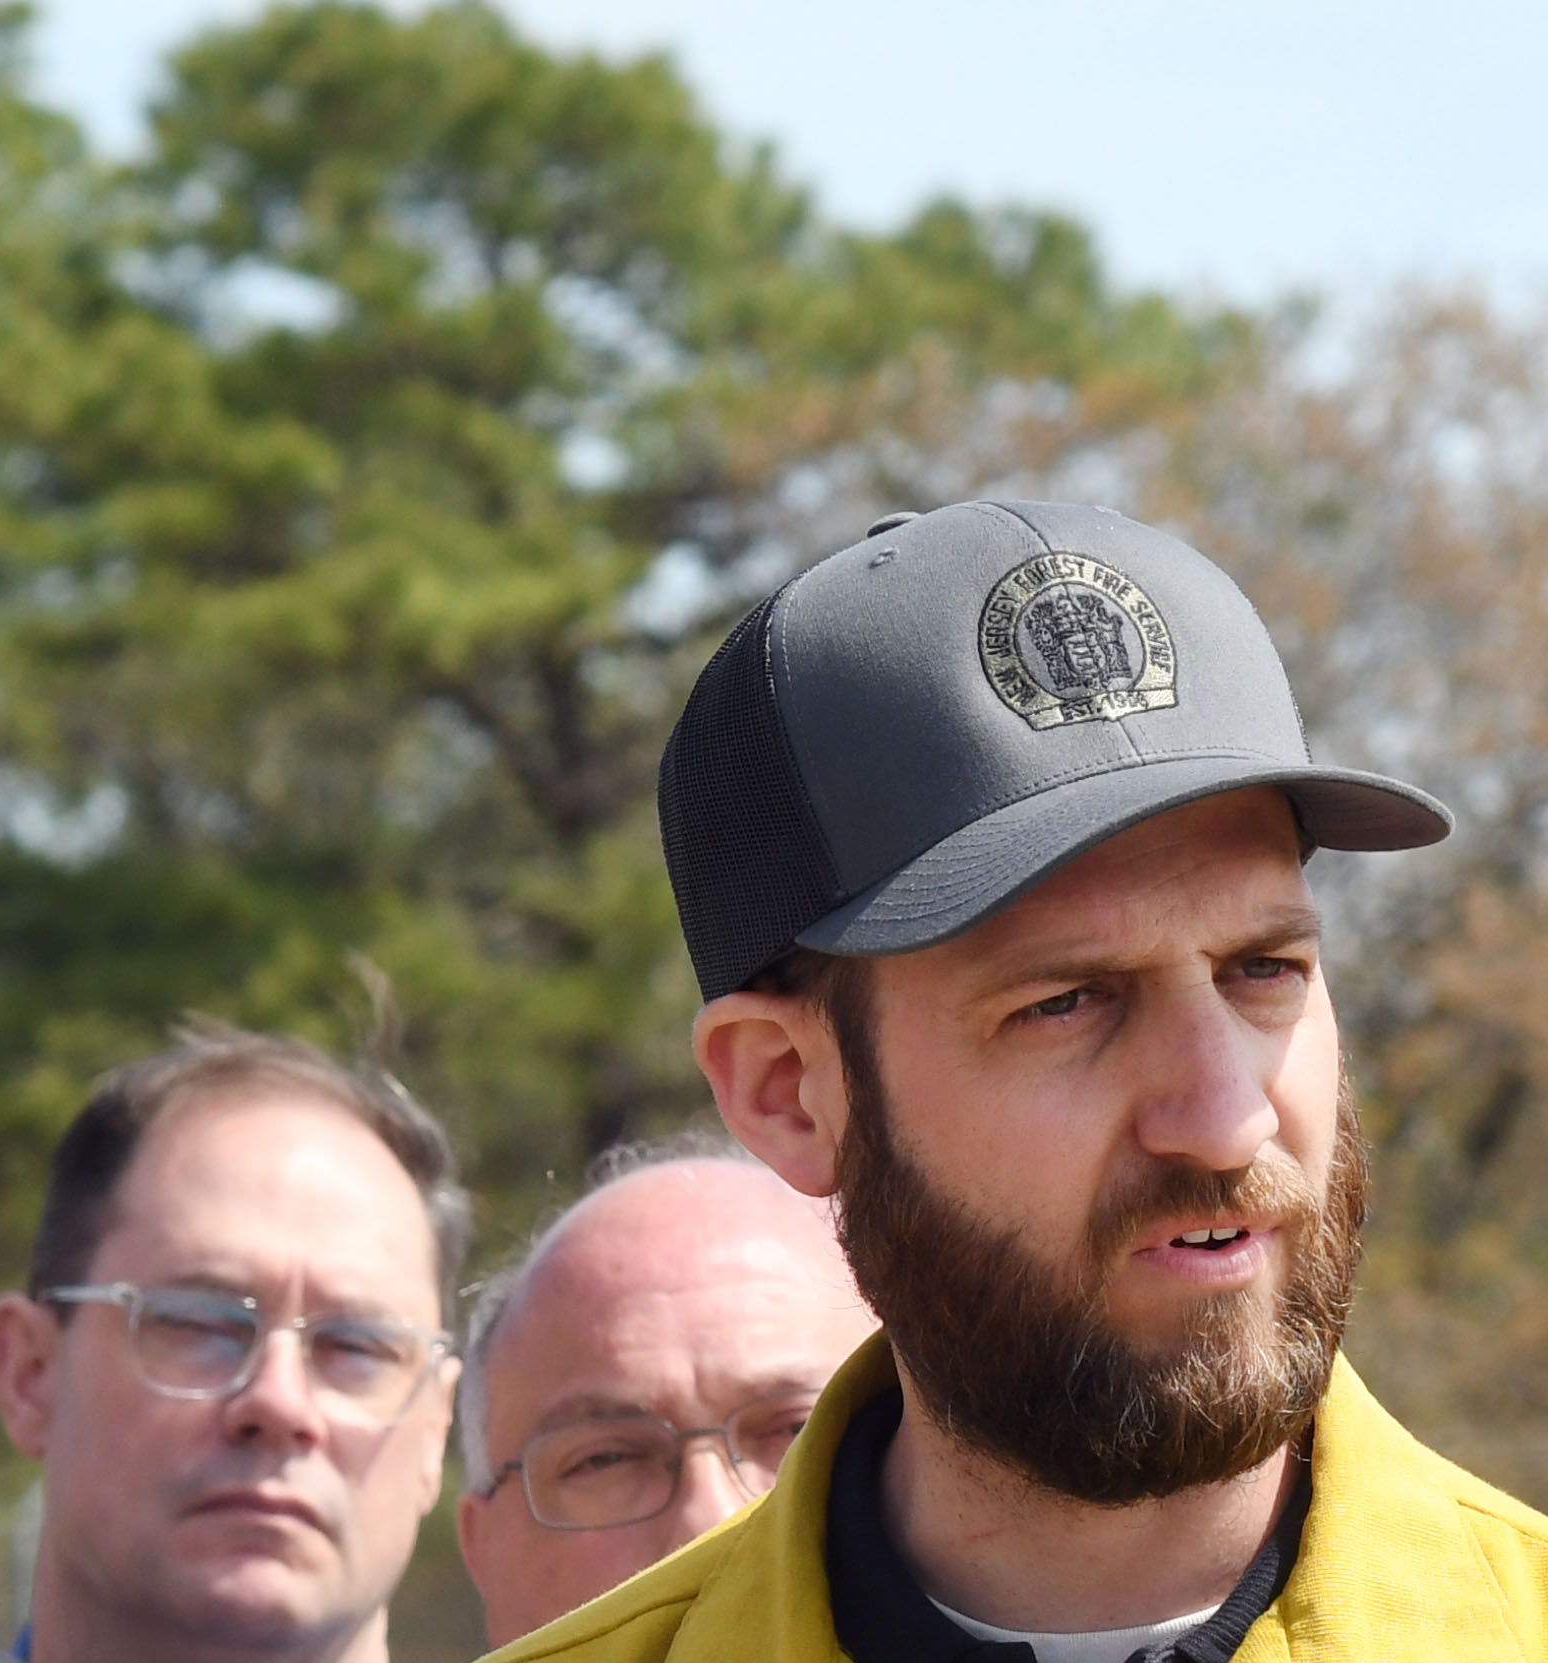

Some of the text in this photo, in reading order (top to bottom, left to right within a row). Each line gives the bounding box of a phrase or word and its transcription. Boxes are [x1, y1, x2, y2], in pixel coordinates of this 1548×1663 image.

[985, 590, 1017, 657] JERSEY
[1013, 556, 1086, 594] FOREST
[1092, 567, 1133, 600] FIRE
[1130, 600, 1173, 674] SERVICE
